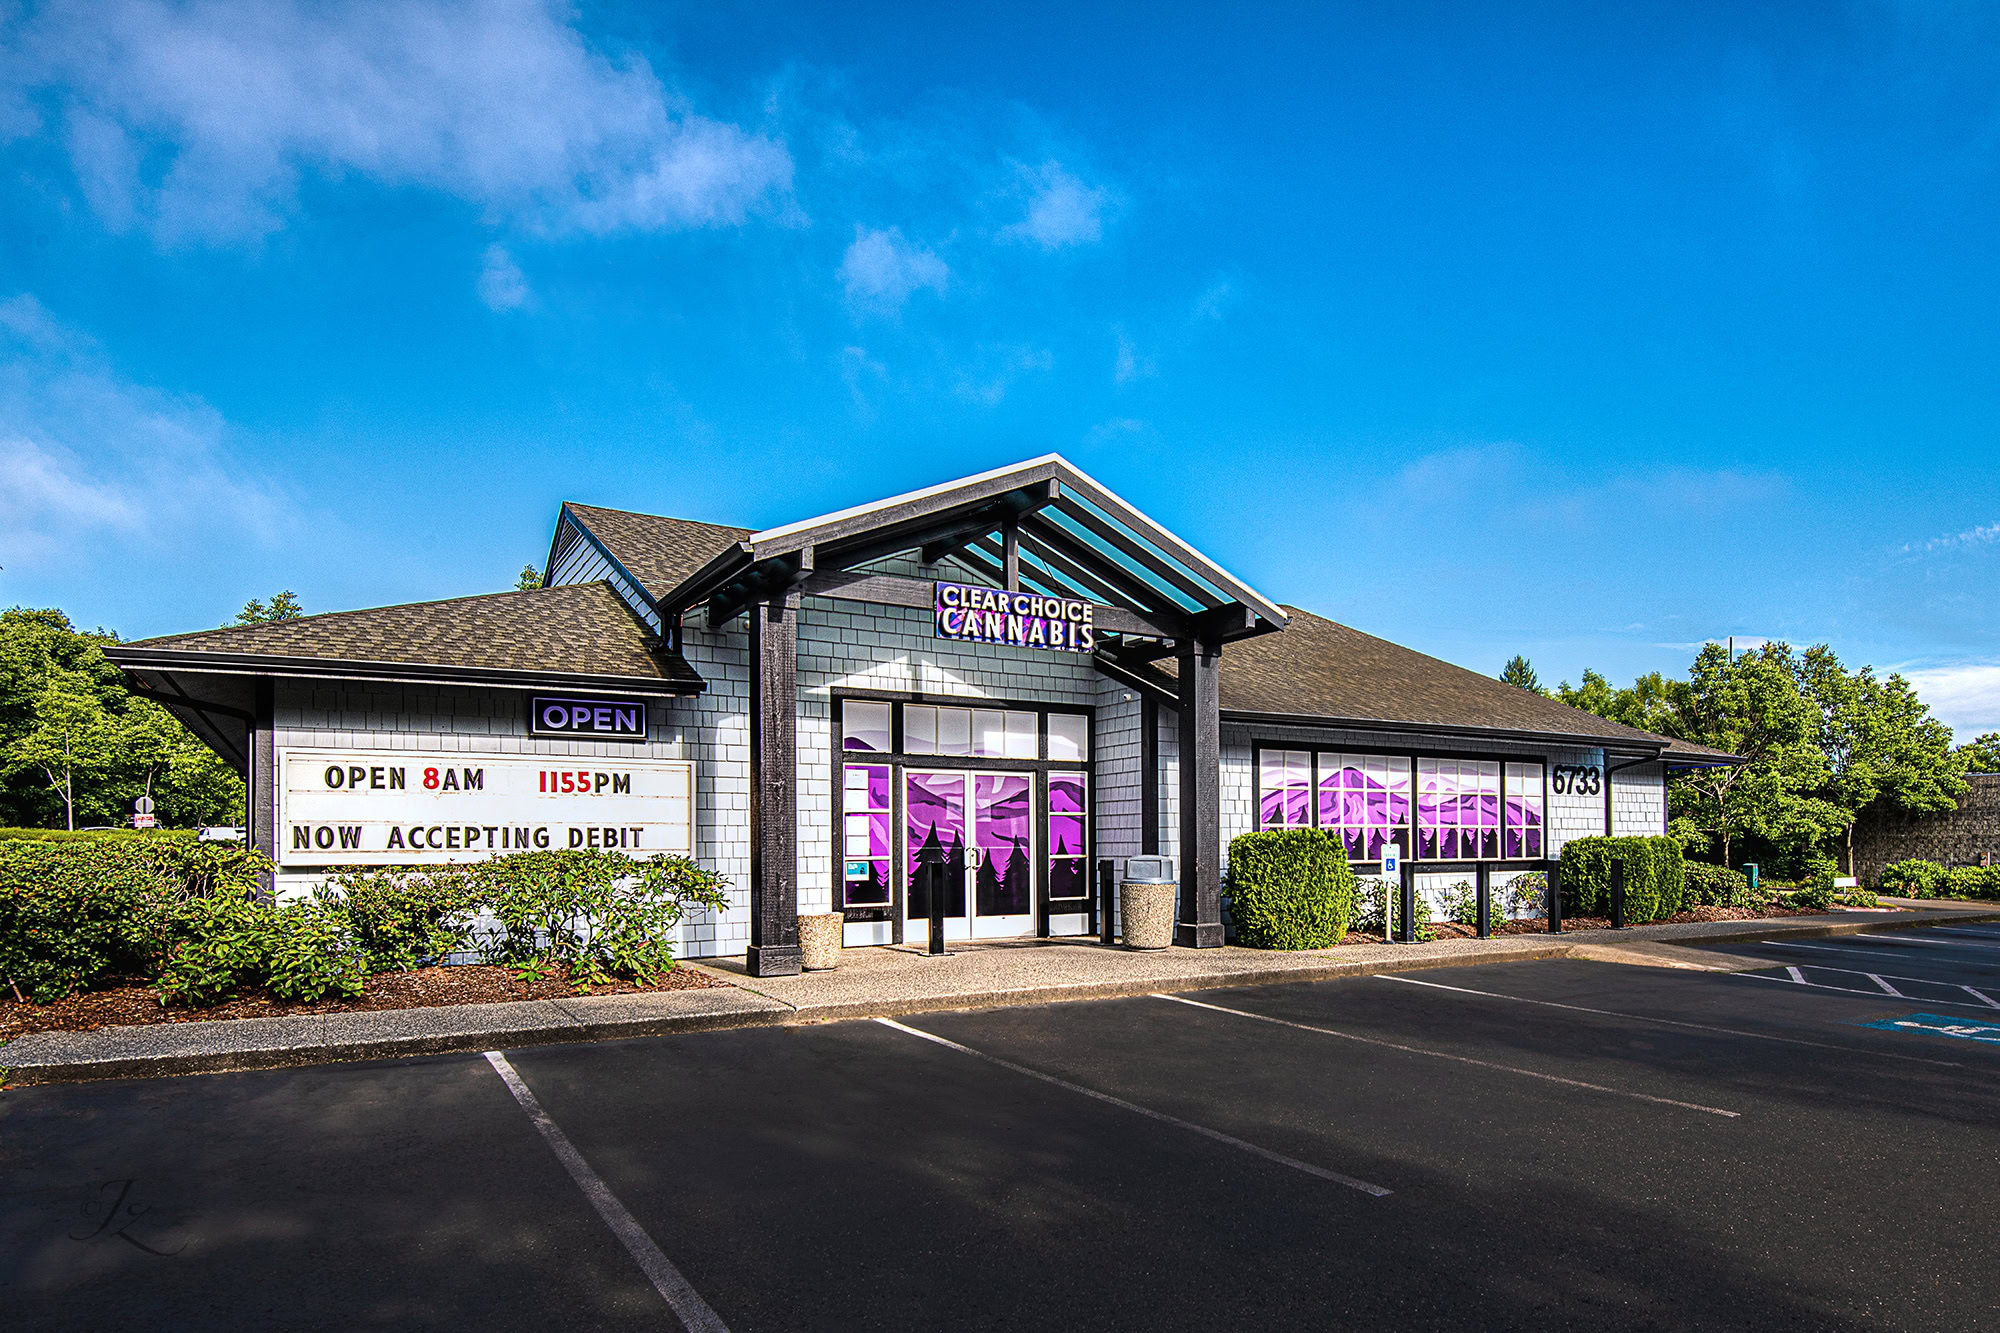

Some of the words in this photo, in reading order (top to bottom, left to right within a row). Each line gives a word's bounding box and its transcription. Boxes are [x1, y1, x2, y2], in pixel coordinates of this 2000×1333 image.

[942, 585, 1010, 613] CLEAR
[1013, 595, 1093, 623] CHOICE
[942, 607, 1094, 649] CANNABIS
[543, 705, 636, 731] OPEN
[325, 765, 406, 790] OPEN
[422, 766, 484, 791] 8AM
[540, 770, 632, 794] 1155PM
[1552, 764, 1601, 796] 6733
[292, 825, 362, 850] NOW
[387, 825, 551, 850] ACCEPTING
[568, 826, 645, 849] DEBIT
